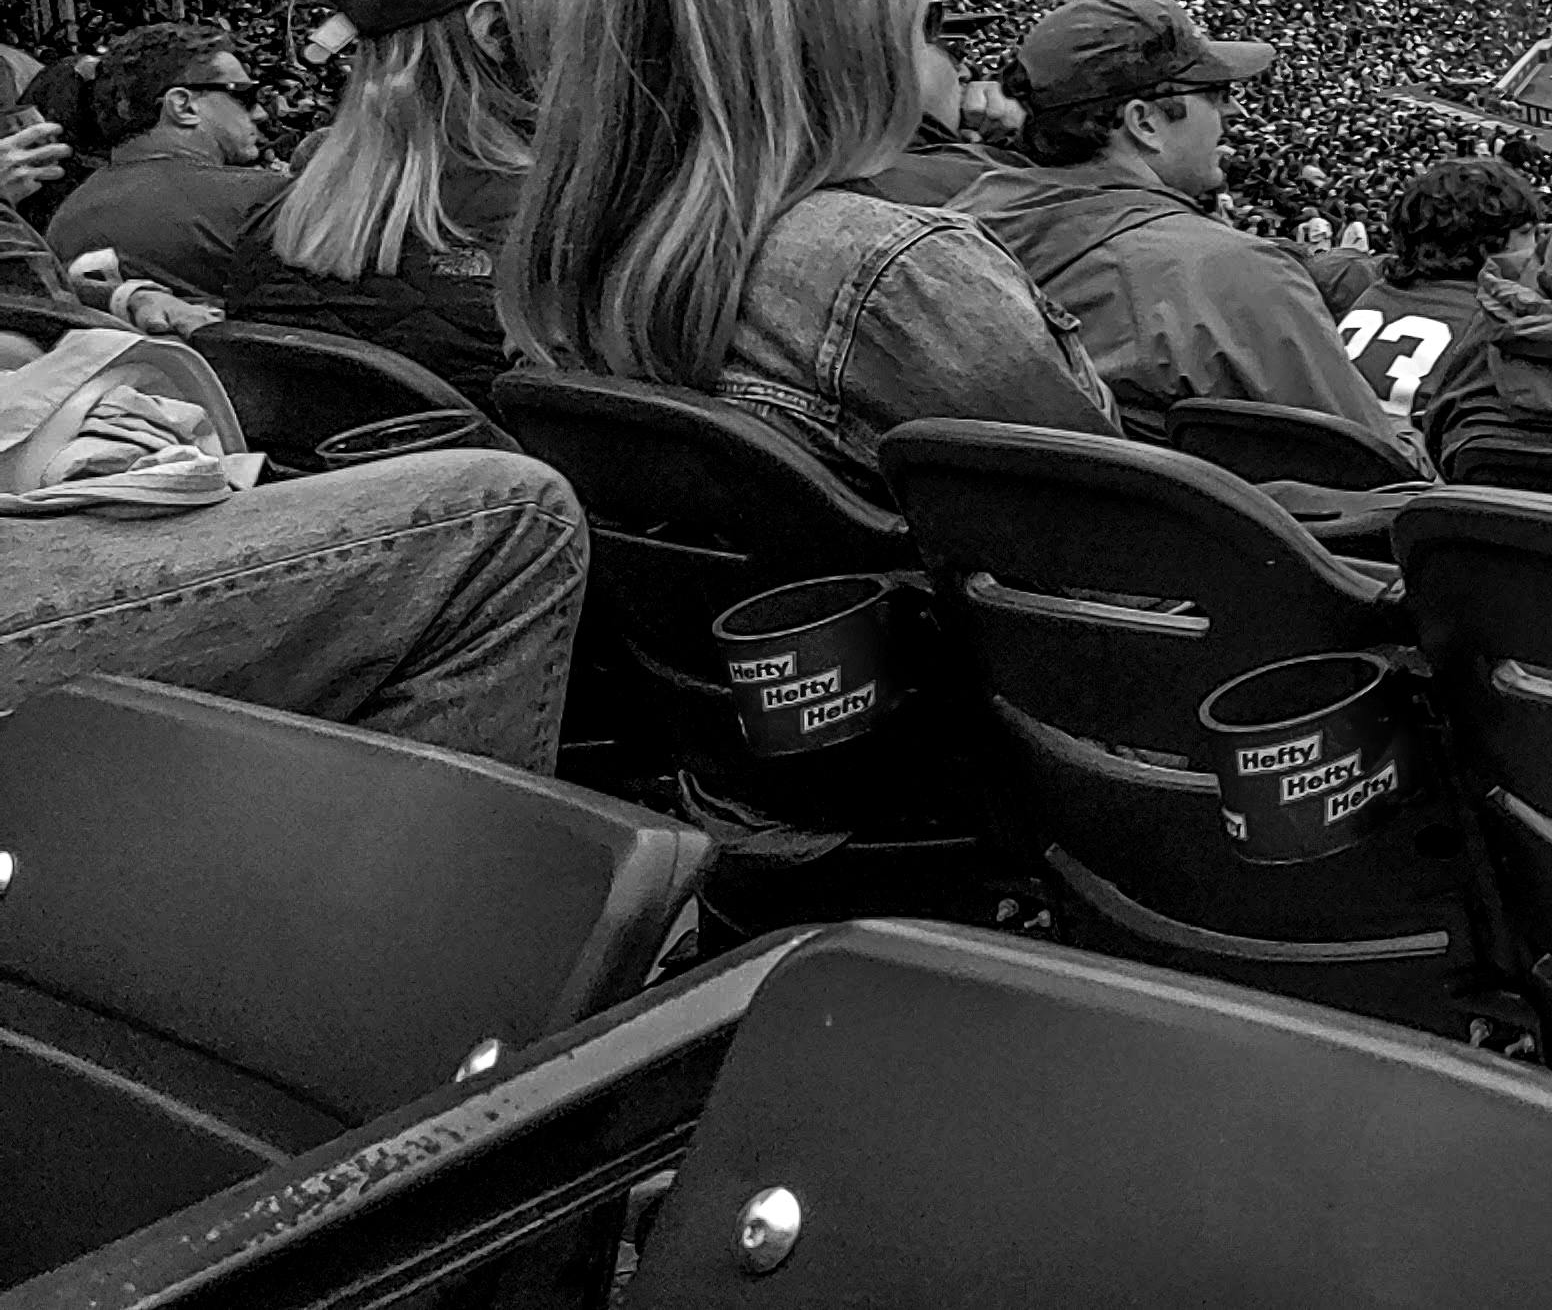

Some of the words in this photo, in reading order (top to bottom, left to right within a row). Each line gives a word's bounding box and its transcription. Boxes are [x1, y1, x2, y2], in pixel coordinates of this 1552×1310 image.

[765, 677, 835, 706] Hefty
[807, 691, 872, 726] Hefty
[1241, 743, 1315, 769] Hefty
[1287, 761, 1356, 796] Hefty
